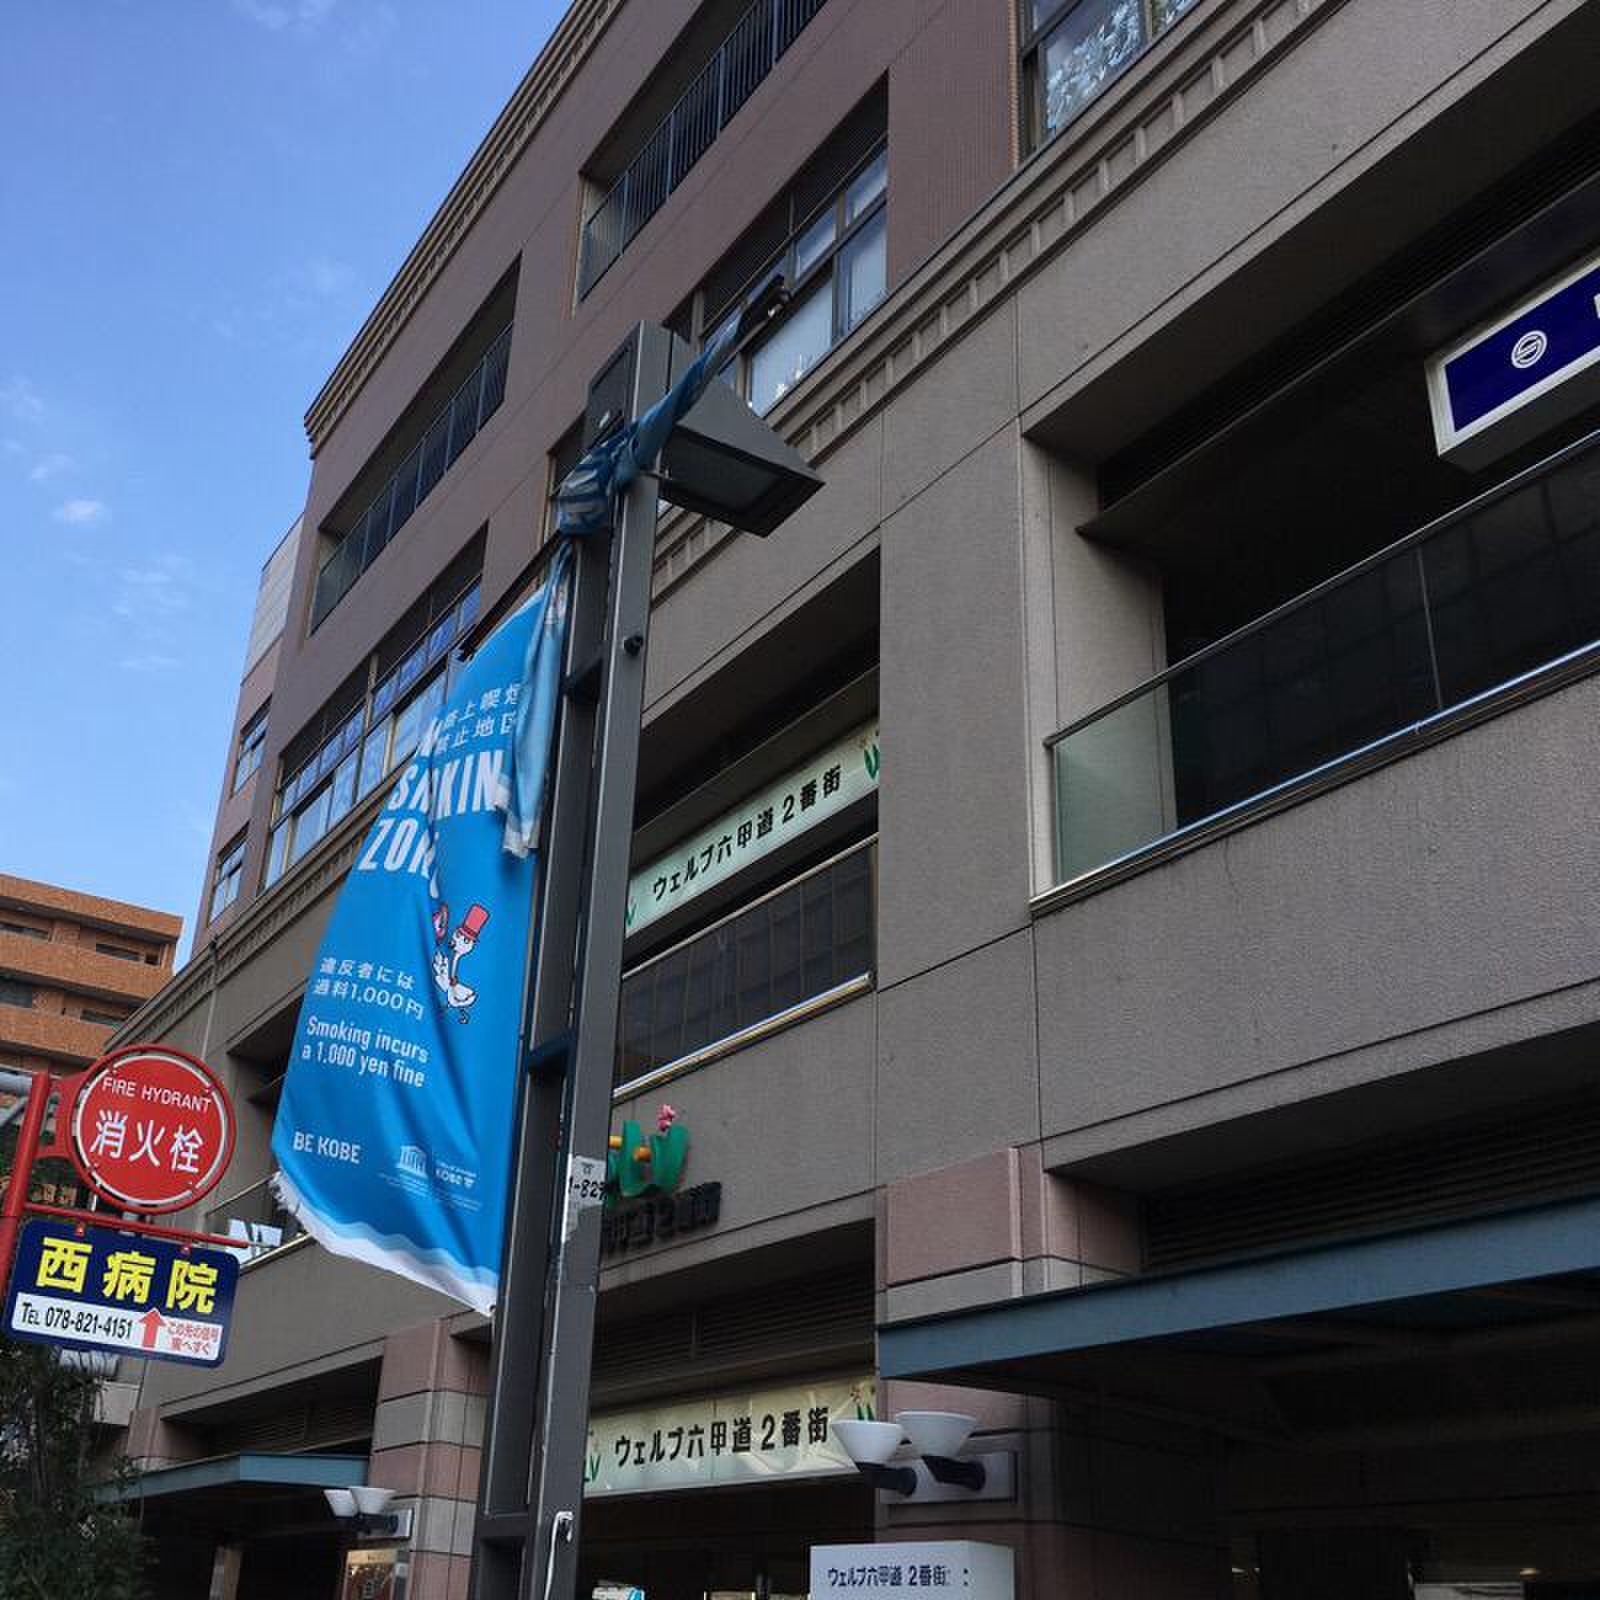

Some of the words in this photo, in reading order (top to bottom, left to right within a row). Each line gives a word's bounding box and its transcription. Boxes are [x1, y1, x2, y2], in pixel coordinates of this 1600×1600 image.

[307, 1016, 371, 1051] Smoking
[375, 1028, 428, 1063] incurs
[302, 1044, 311, 1060] a
[359, 1055, 389, 1078] yen
[393, 1059, 425, 1088] fine
[103, 1076, 136, 1097] FIRE
[142, 1086, 211, 1113] HYDRANT
[90, 1109, 204, 1173] 消火栓
[293, 1131, 314, 1152] BE
[318, 1135, 361, 1164] KOBE
[36, 1237, 220, 1314] 西病院
[45, 1306, 133, 1340] 078-821-4151
